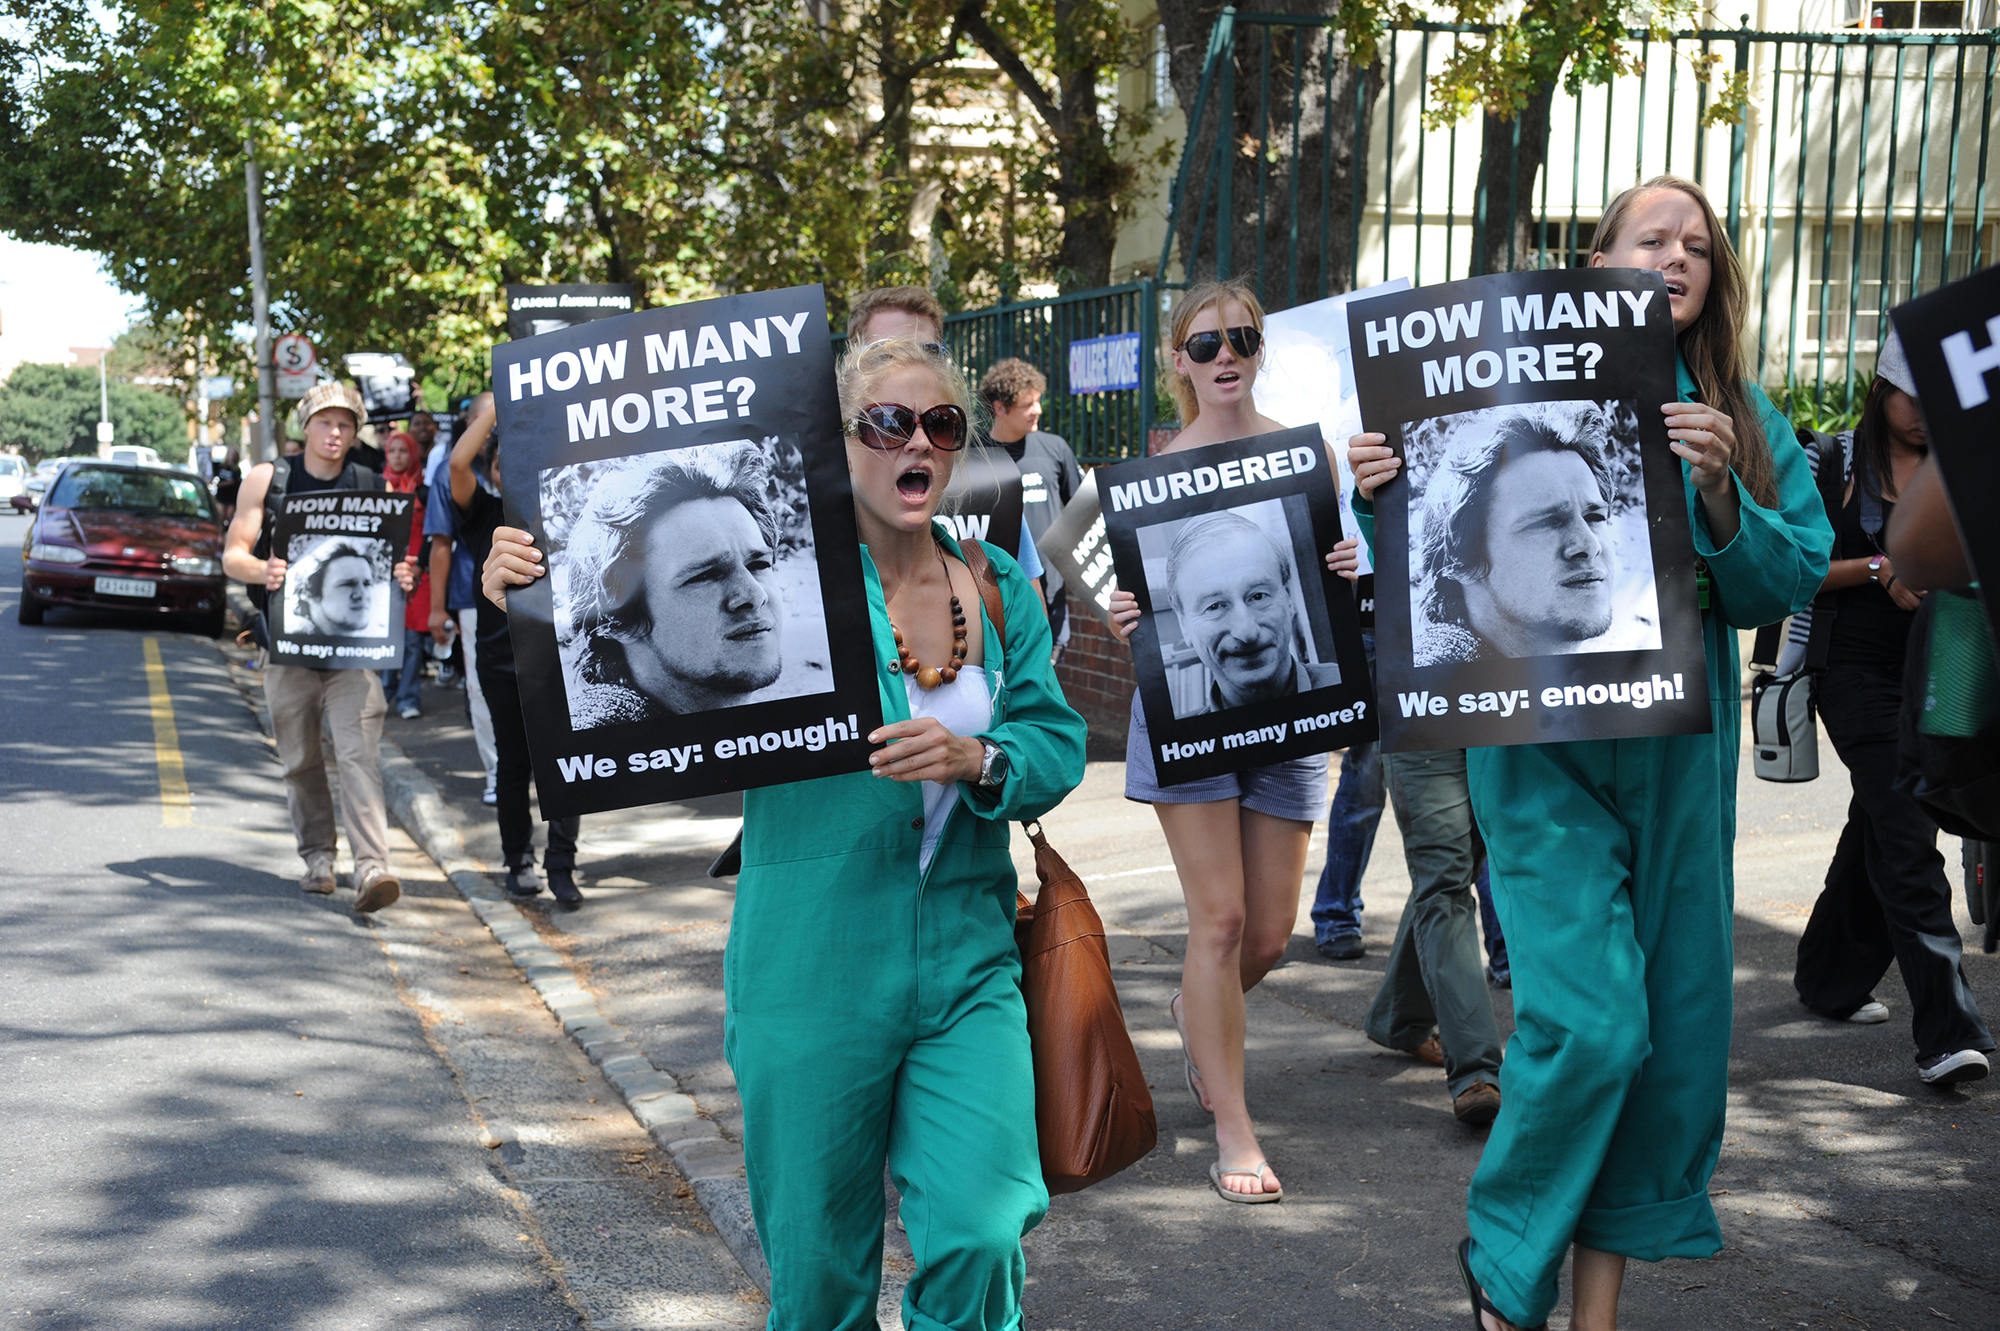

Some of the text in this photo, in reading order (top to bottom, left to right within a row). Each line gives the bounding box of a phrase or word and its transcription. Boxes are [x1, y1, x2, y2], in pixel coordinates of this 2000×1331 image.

[1364, 290, 1655, 358] HOW MANY
[286, 345, 302, 364] S
[509, 311, 810, 401] HOW MANY
[1422, 342, 1604, 398] MORE?
[566, 376, 757, 443] MORE?
[286, 497, 408, 515] HOW MANY
[1109, 446, 1317, 512] MURDERED
[305, 514, 382, 532] MORE?
[931, 514, 990, 541] OW
[277, 640, 395, 659] We say: enough!
[1397, 673, 1685, 718] We say: enough!
[556, 714, 860, 783] We say: enough!
[1161, 701, 1367, 762] How many more?
